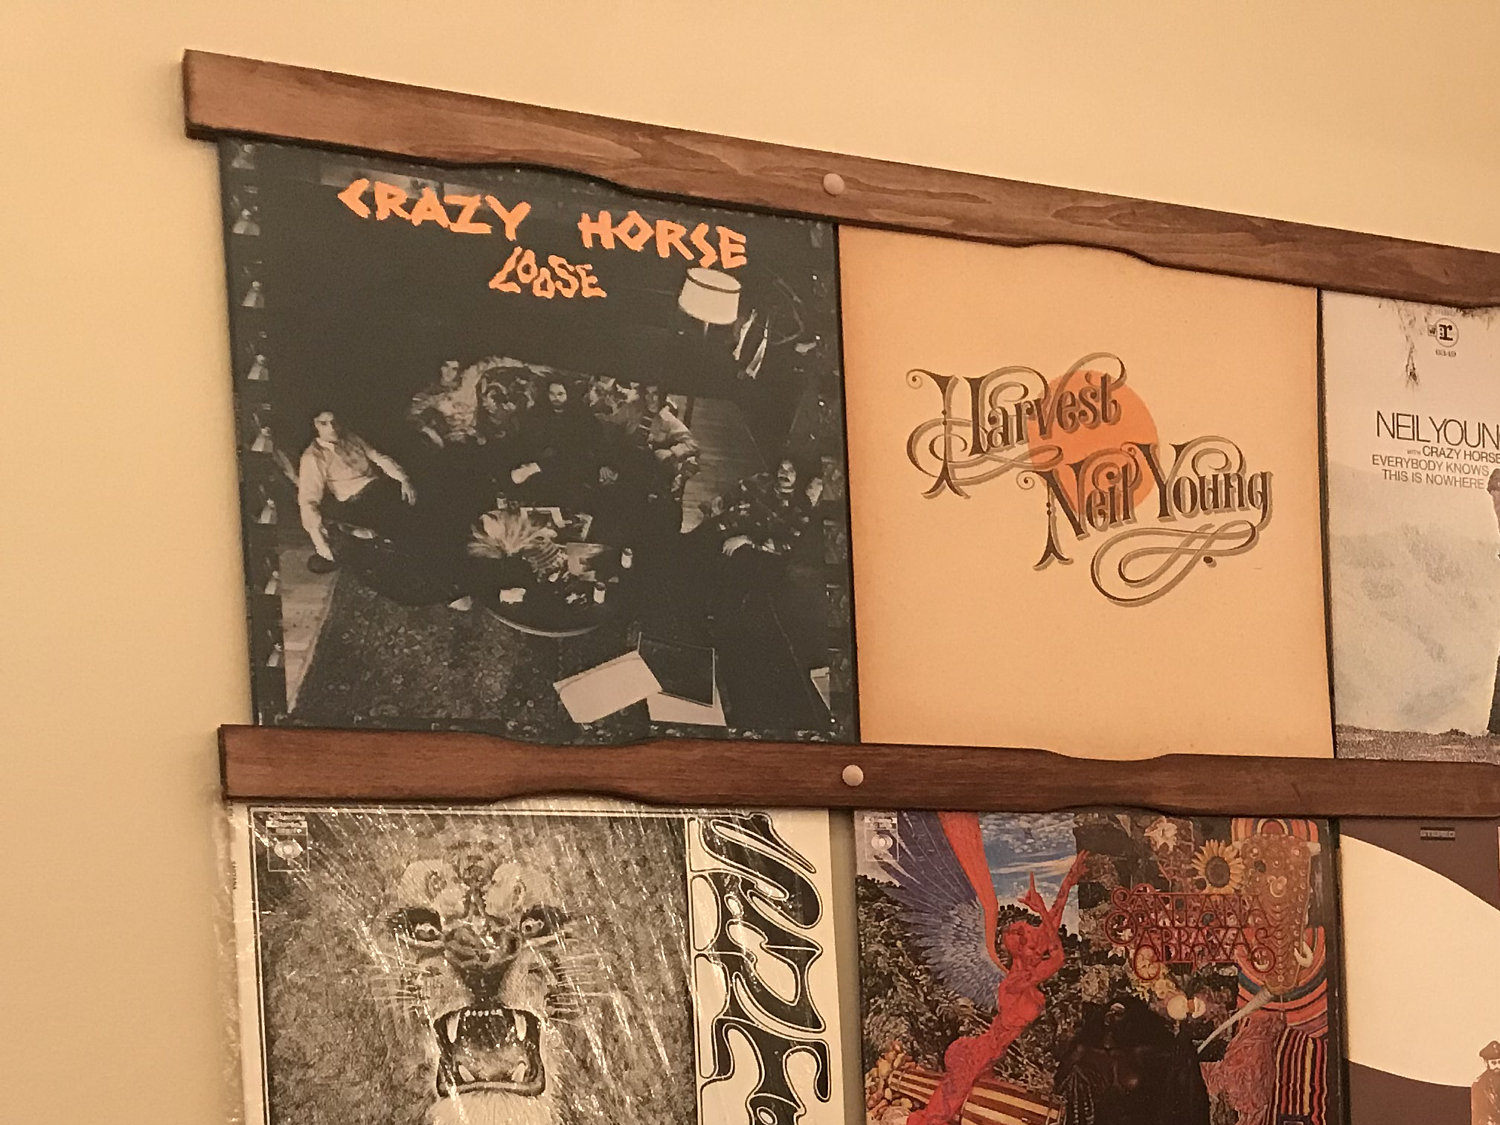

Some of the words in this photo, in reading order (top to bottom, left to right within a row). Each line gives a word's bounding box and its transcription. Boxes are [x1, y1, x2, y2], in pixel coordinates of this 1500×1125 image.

[338, 178, 531, 241] CRAZY
[578, 210, 747, 269] HORSE
[489, 247, 607, 299] LOOSE
[906, 352, 1126, 498] Harvest
[1377, 410, 1431, 443] NEIL
[1372, 454, 1443, 472] EVERYBODY
[1445, 463, 1490, 477] KNOWS
[1423, 445, 1461, 460] CRAZY
[1382, 468, 1409, 482] THIS
[1412, 471, 1422, 484] IS
[1426, 474, 1485, 489] NOWHERE
[1016, 446, 1141, 570] Neil
[1091, 436, 1273, 607] Young
